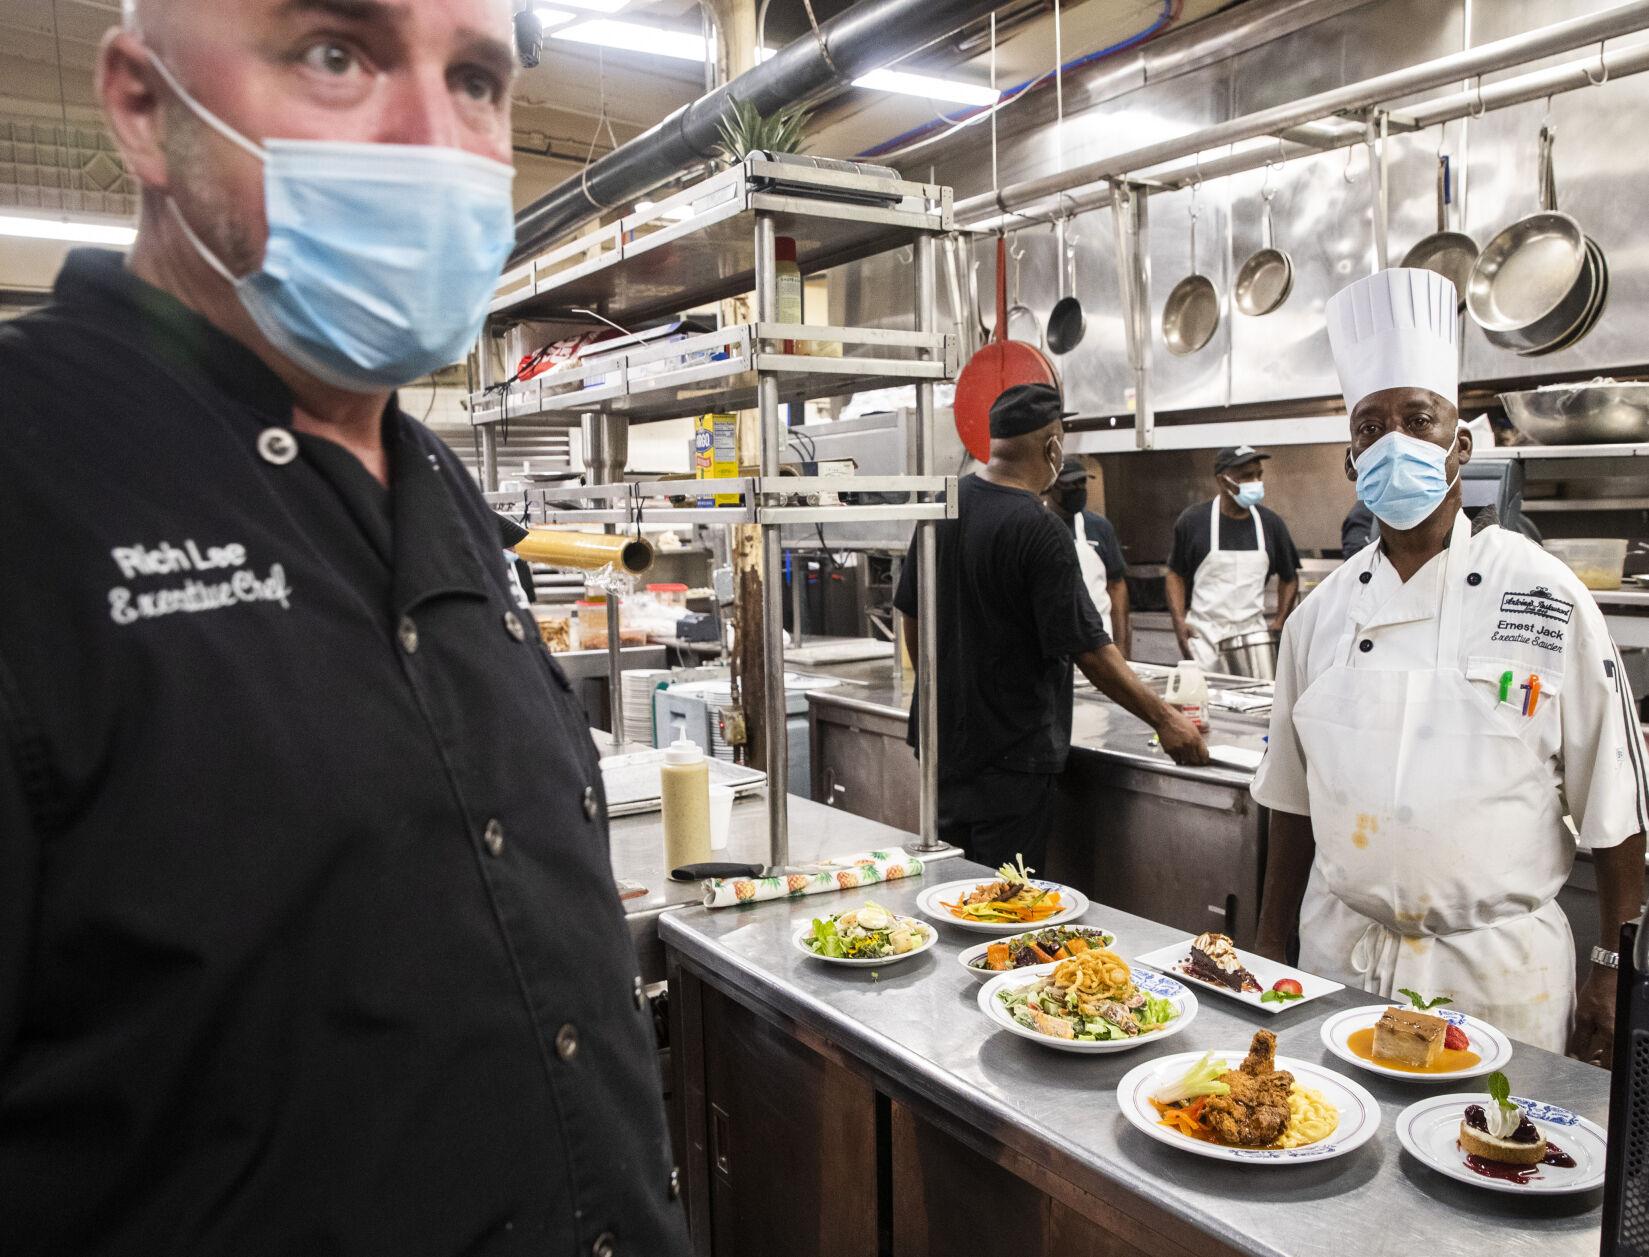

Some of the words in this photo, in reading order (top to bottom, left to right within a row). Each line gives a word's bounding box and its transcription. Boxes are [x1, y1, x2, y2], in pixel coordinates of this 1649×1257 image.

[111, 541, 191, 579] Rich
[184, 537, 247, 570] Lee
[1491, 631, 1530, 644] Executive
[1497, 620, 1535, 632] Ernest
[1537, 626, 1564, 641] Jack
